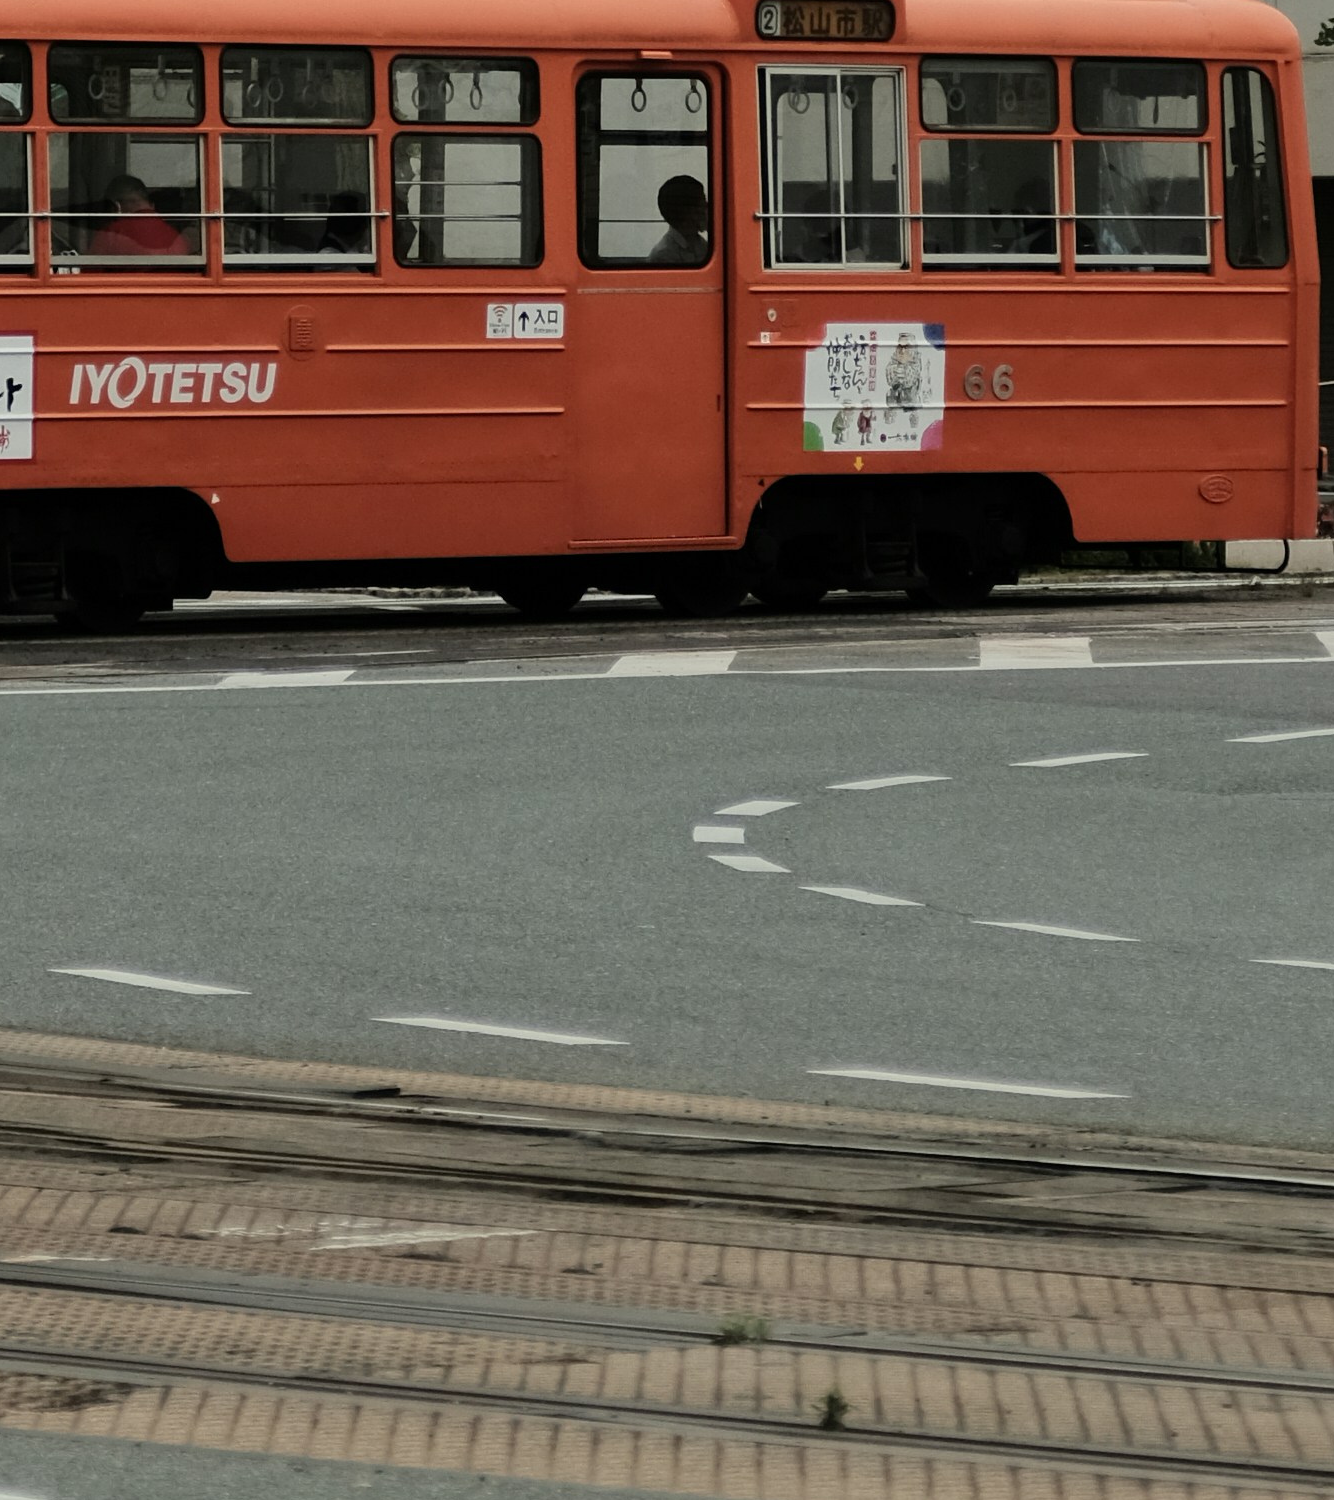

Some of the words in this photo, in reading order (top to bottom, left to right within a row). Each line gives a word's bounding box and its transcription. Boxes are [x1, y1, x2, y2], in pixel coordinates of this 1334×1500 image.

[763, 9, 774, 31] 2
[782, 5, 884, 37] 松山市駅
[534, 309, 558, 325] 入口
[69, 356, 277, 408] IYOTETSU
[964, 364, 1015, 401] 66
